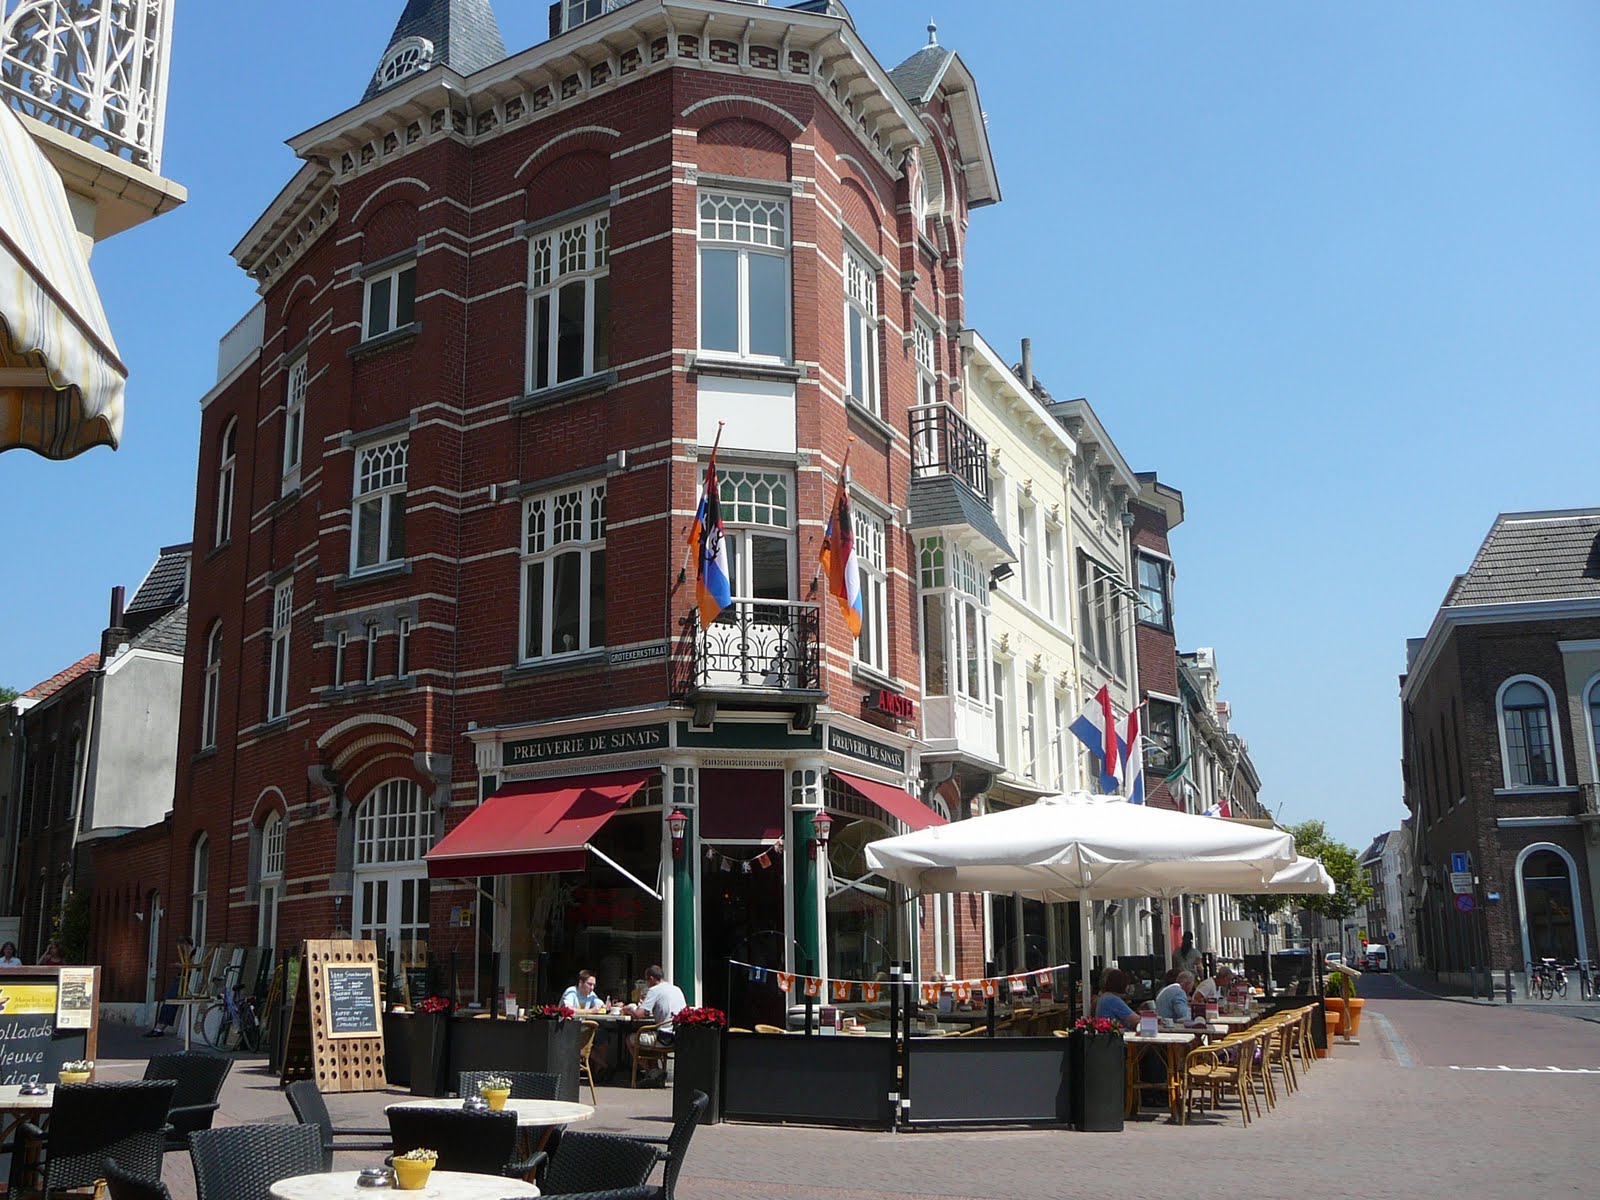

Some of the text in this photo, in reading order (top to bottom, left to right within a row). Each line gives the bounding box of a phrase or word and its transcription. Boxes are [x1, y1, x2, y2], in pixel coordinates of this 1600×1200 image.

[611, 646, 667, 663] GROTEKERKSTRAAT
[880, 689, 917, 720] AMSTEL
[513, 730, 660, 760] PREUVERIE DE SJNATS
[832, 733, 869, 757] PREUVERIE
[870, 745, 880, 760] DE
